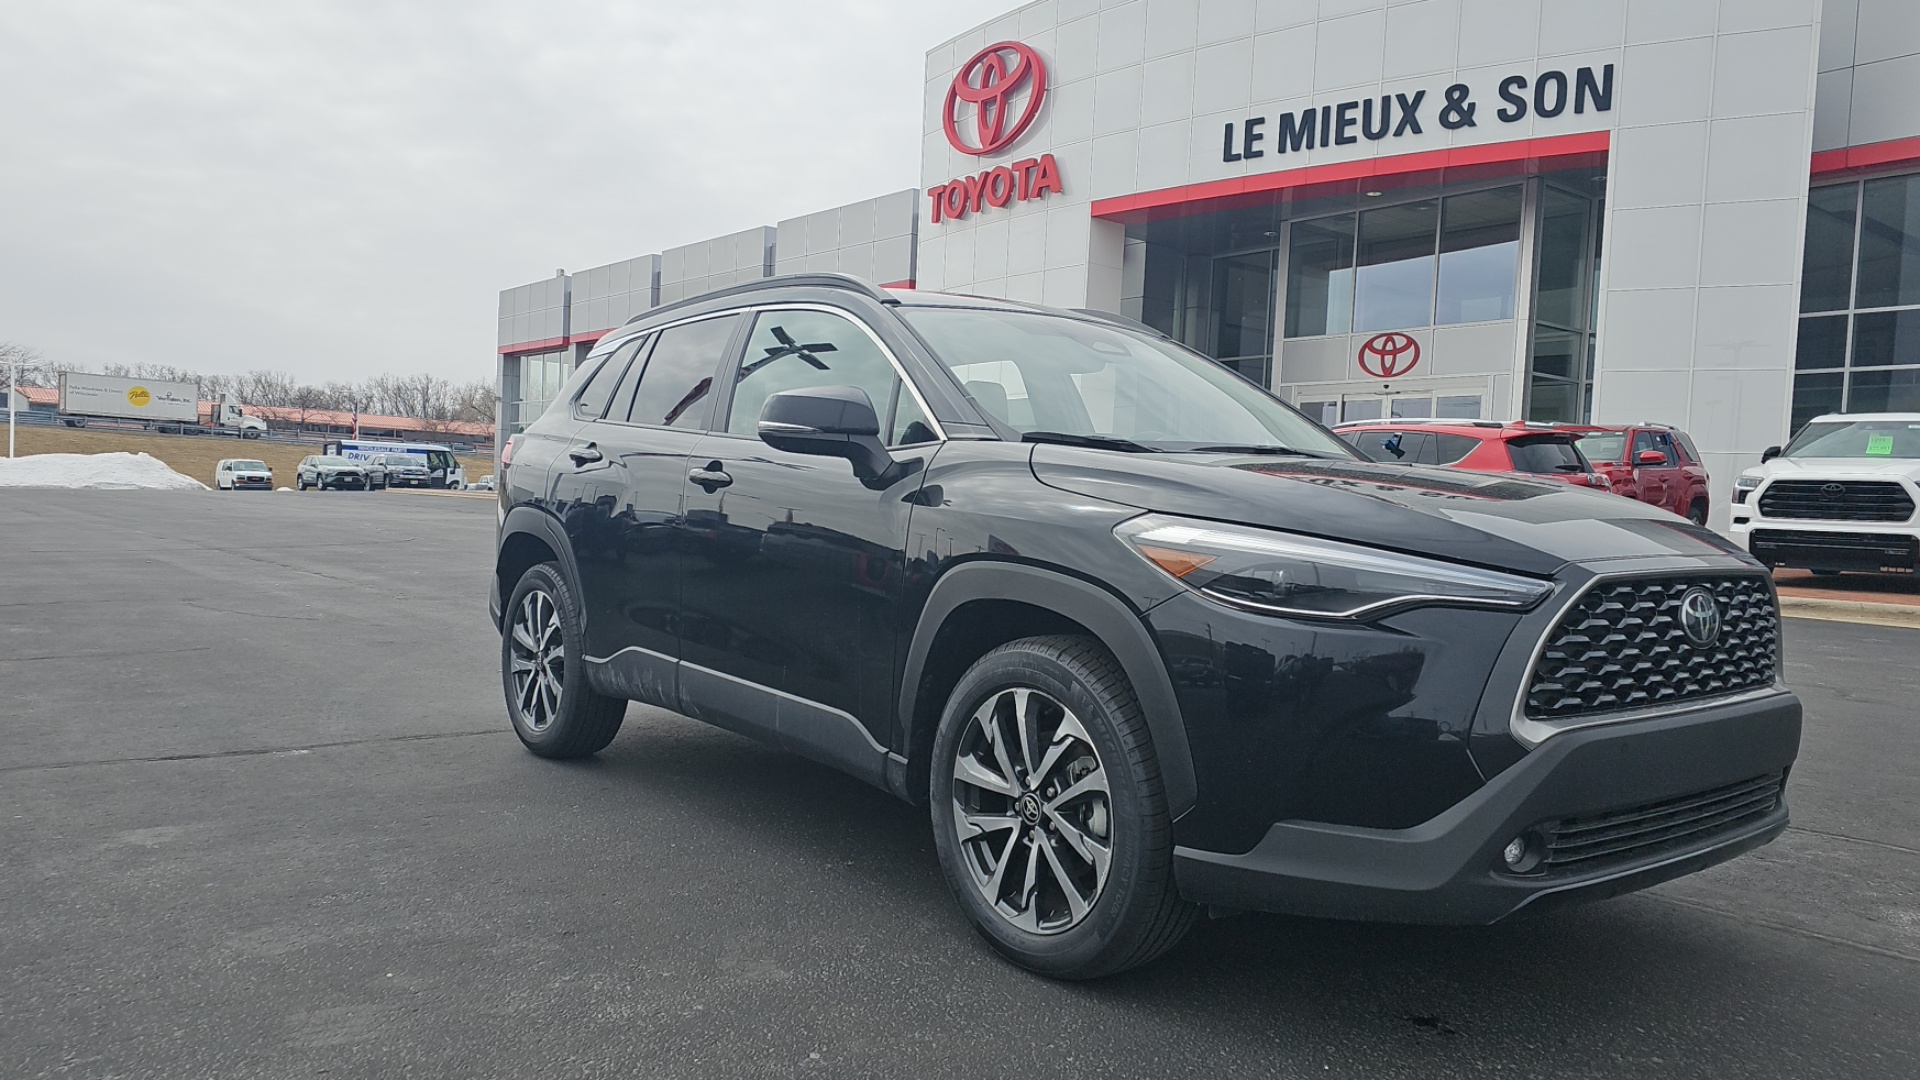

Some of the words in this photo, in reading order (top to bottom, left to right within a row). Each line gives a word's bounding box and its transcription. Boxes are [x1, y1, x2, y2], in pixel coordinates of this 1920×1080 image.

[1223, 117, 1266, 162] LE
[1278, 90, 1426, 153] MIEUX
[1438, 83, 1477, 131] &
[1496, 64, 1614, 123] SON
[928, 154, 1063, 224] TOYOTA
